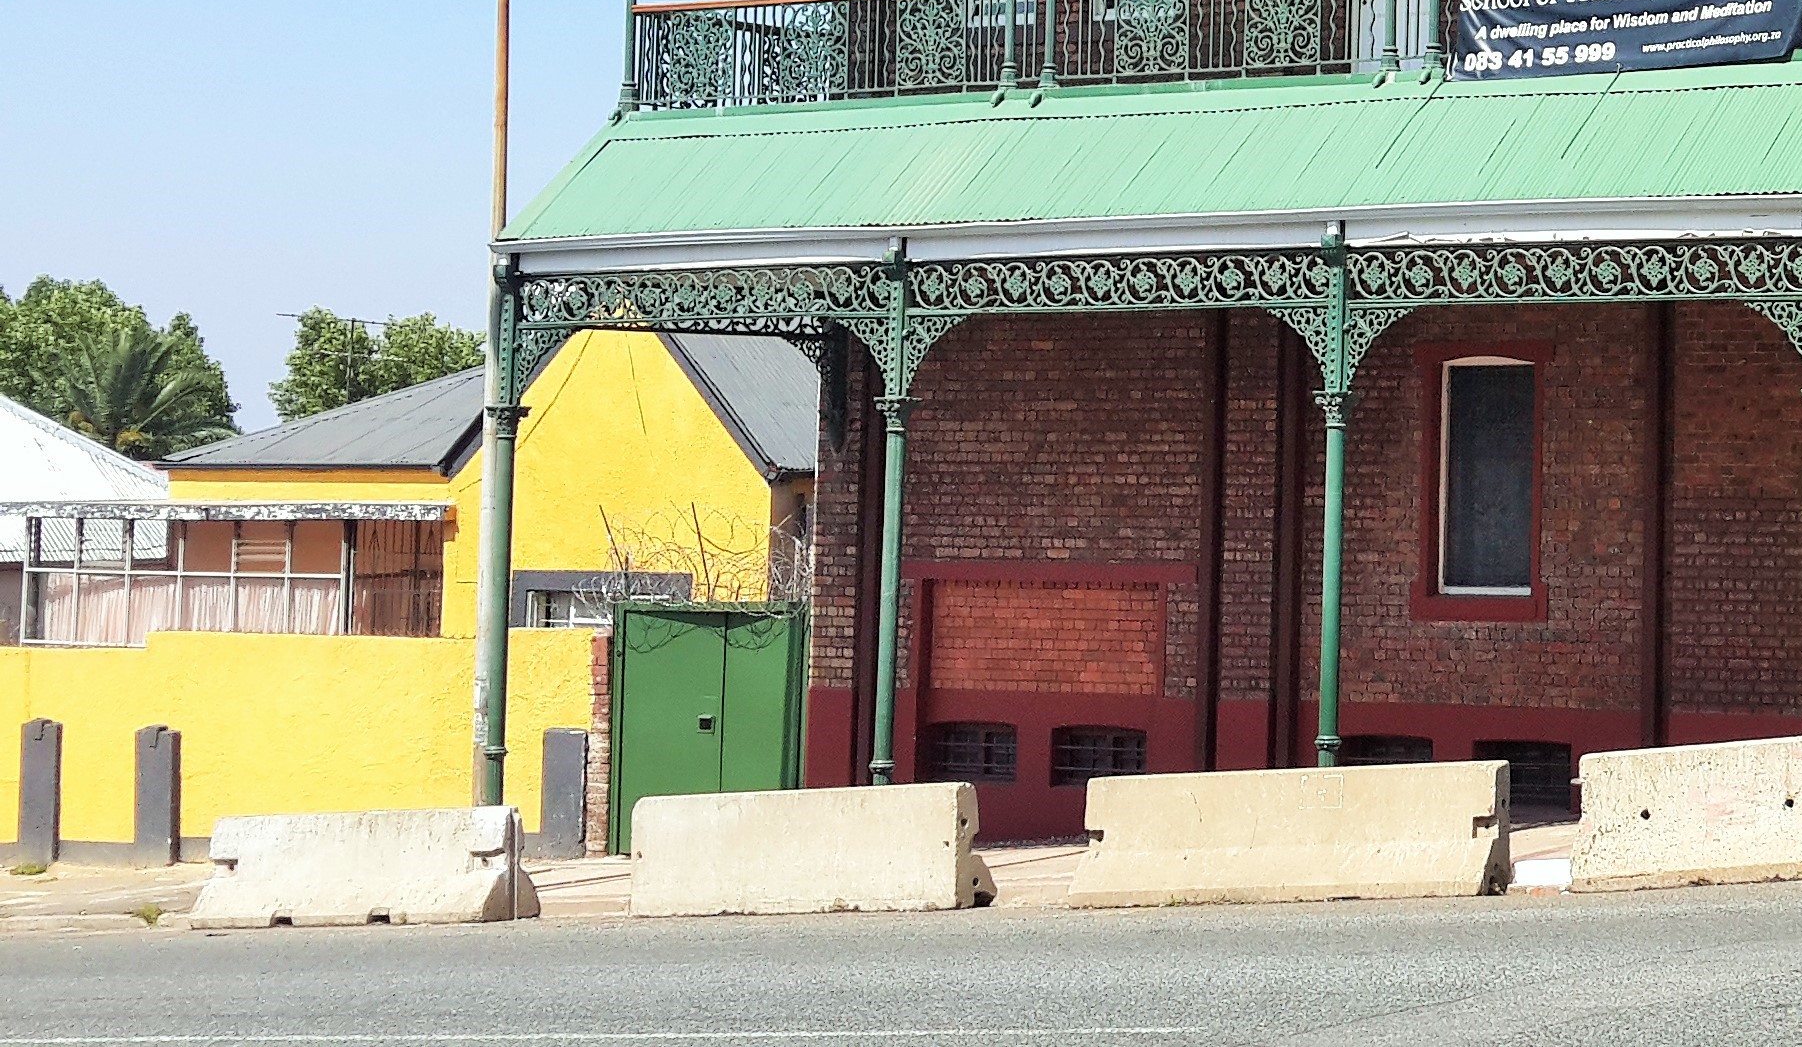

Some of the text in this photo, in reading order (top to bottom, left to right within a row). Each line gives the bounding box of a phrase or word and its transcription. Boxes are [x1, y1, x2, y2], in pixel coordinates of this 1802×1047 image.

[1474, 25, 1488, 40] A
[1490, 22, 1549, 40] dwelling
[1549, 18, 1588, 38] place
[1589, 16, 1611, 31] for
[1612, 10, 1669, 29] Wisdom
[1671, 6, 1699, 23] and
[1464, 41, 1616, 72] 083 41 55 999
[1641, 29, 1782, 53] www.practicalphilosophy.org.za
